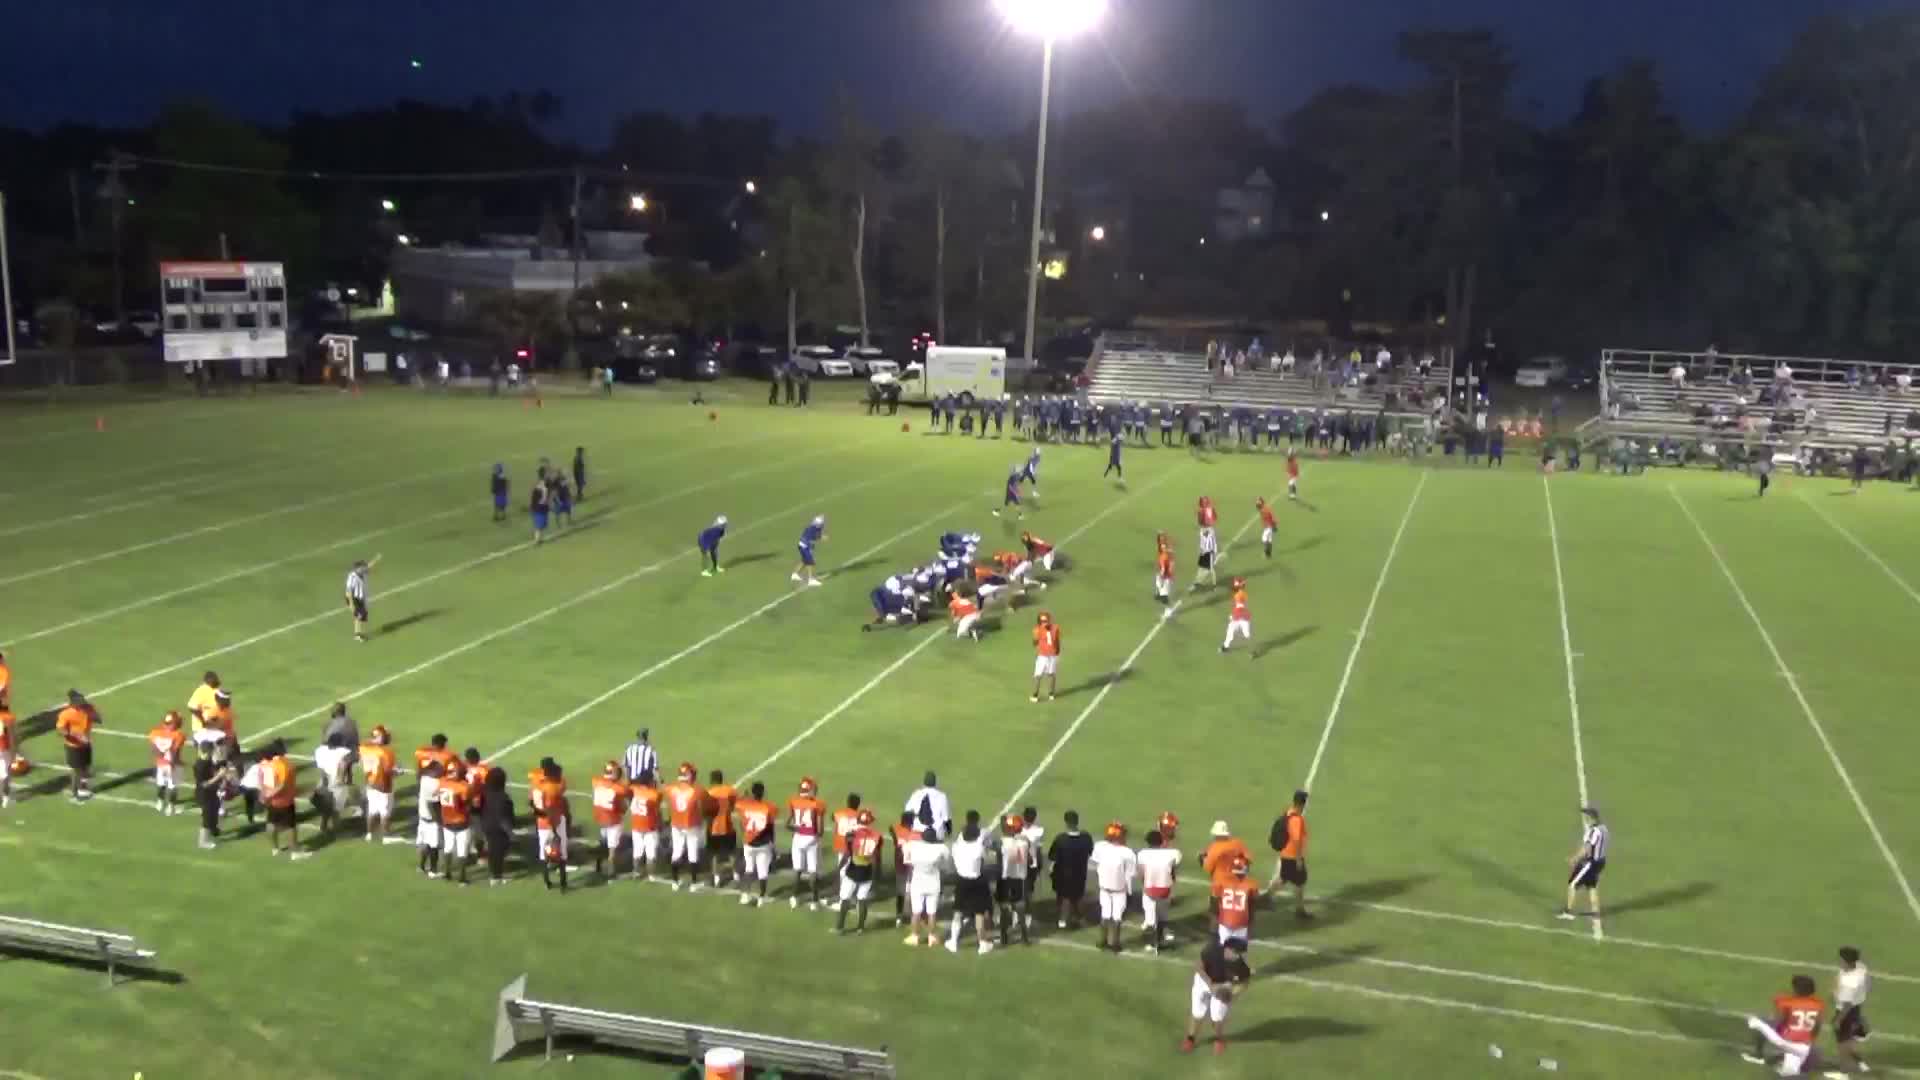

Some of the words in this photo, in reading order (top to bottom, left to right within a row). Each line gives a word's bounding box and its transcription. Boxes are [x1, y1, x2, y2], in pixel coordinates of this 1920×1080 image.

[793, 808, 813, 827] 14
[1221, 888, 1247, 911] 23
[1789, 1010, 1818, 1031] 35
